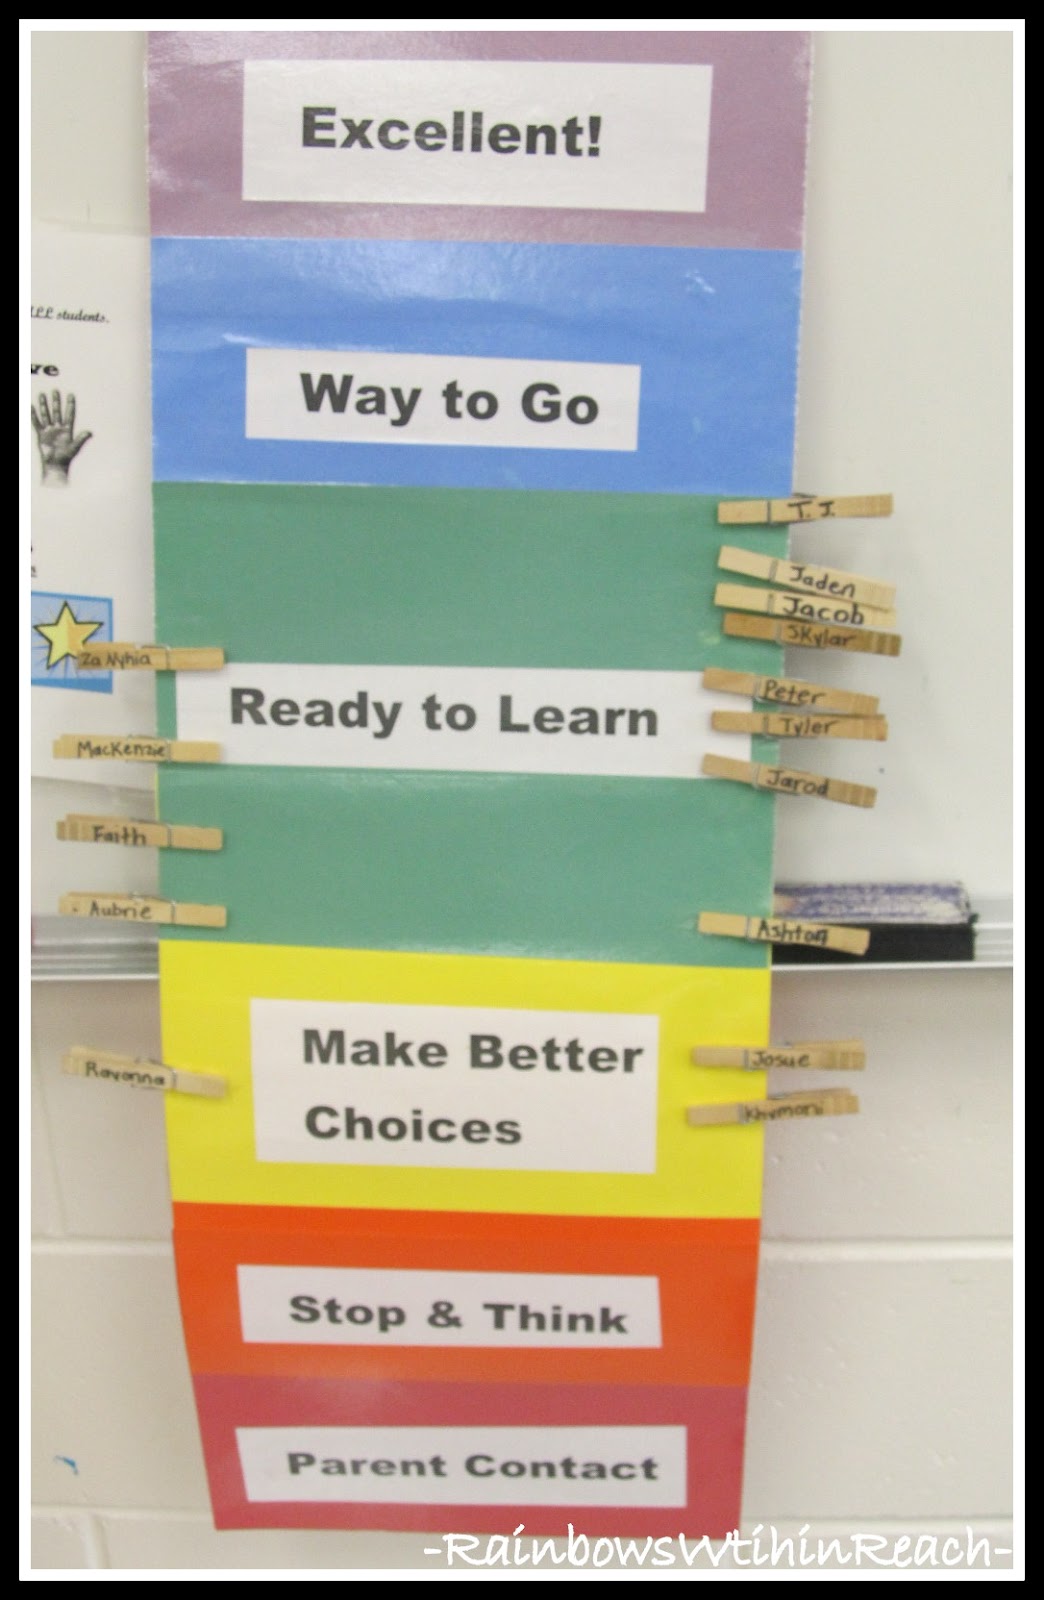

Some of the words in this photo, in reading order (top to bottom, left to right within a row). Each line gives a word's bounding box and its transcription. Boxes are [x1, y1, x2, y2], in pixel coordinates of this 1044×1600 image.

[302, 106, 601, 157] Excellent!
[300, 373, 422, 427] Way
[442, 380, 499, 420] to
[521, 382, 599, 425] Go
[789, 564, 856, 598] Jaden
[782, 596, 865, 625] Jacob
[764, 678, 826, 704] Peter
[231, 687, 402, 739] Ready
[422, 694, 477, 731] to
[500, 695, 658, 736] Learn
[779, 717, 840, 737] Tyler
[766, 769, 830, 796] Jarod
[92, 825, 147, 847] Faith
[89, 900, 153, 920] Aubrie
[304, 1029, 448, 1068] Make
[470, 1034, 643, 1073] Better
[752, 1051, 811, 1067] Josue
[305, 1105, 521, 1145] Choices
[289, 1295, 407, 1334] Stop
[427, 1301, 463, 1328] &
[482, 1303, 627, 1334] Think
[287, 1452, 447, 1477] Parent
[464, 1453, 658, 1480] Contact
